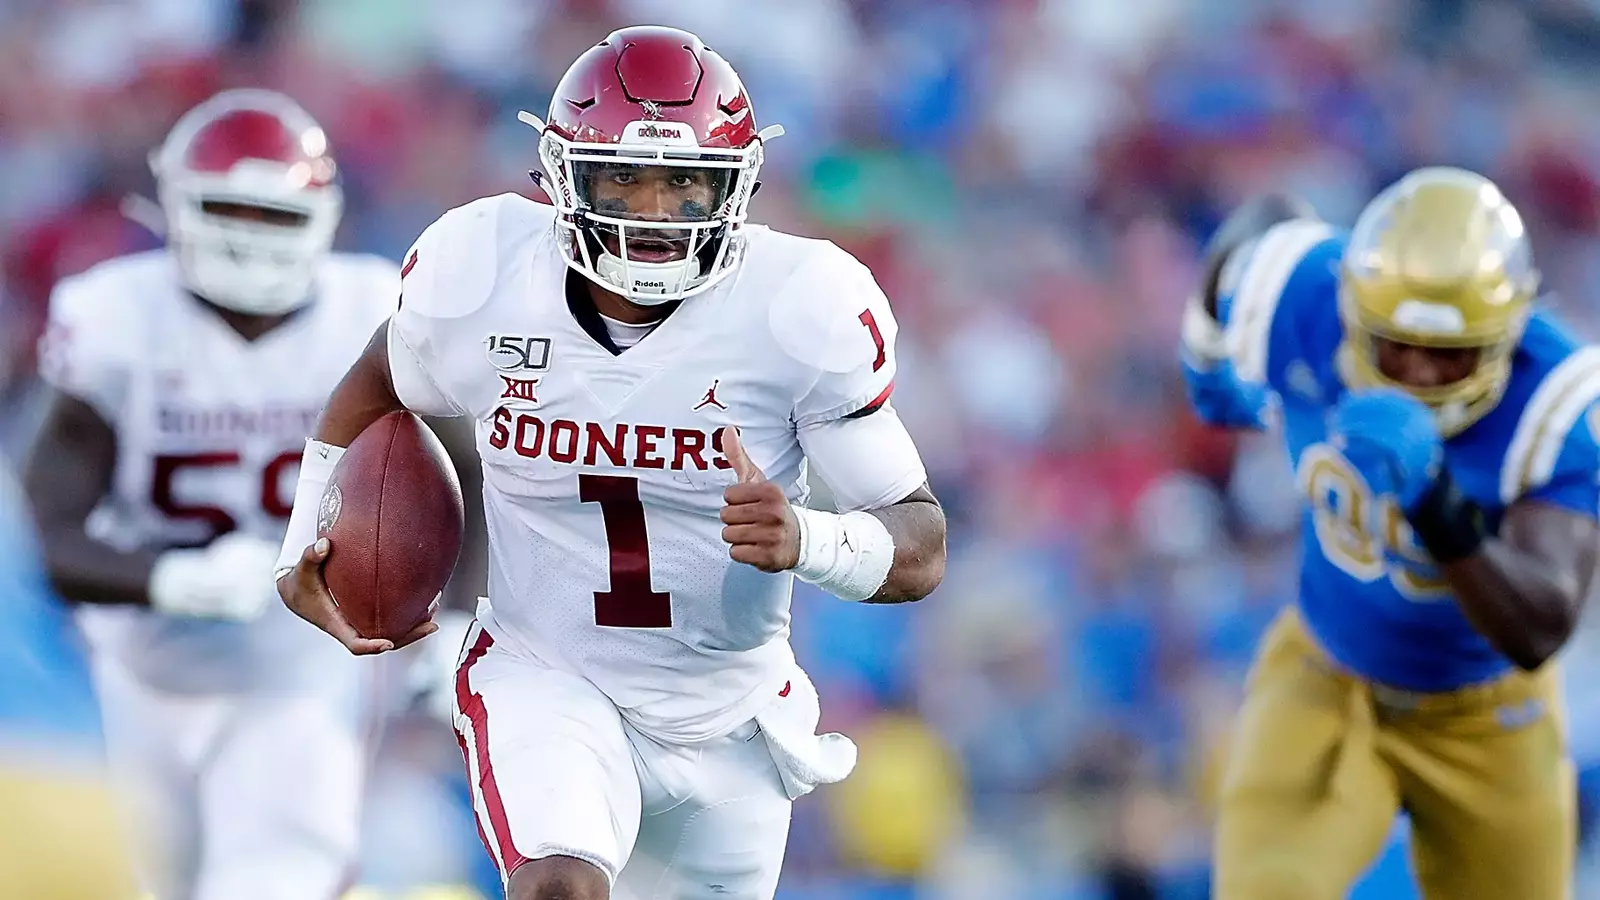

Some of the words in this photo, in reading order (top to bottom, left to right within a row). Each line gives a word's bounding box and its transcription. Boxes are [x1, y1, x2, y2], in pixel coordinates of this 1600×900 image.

[634, 280, 665, 288] Riddell
[488, 335, 551, 370] 150
[858, 308, 886, 373] 1
[499, 374, 539, 403] XII
[578, 473, 673, 628] 1
